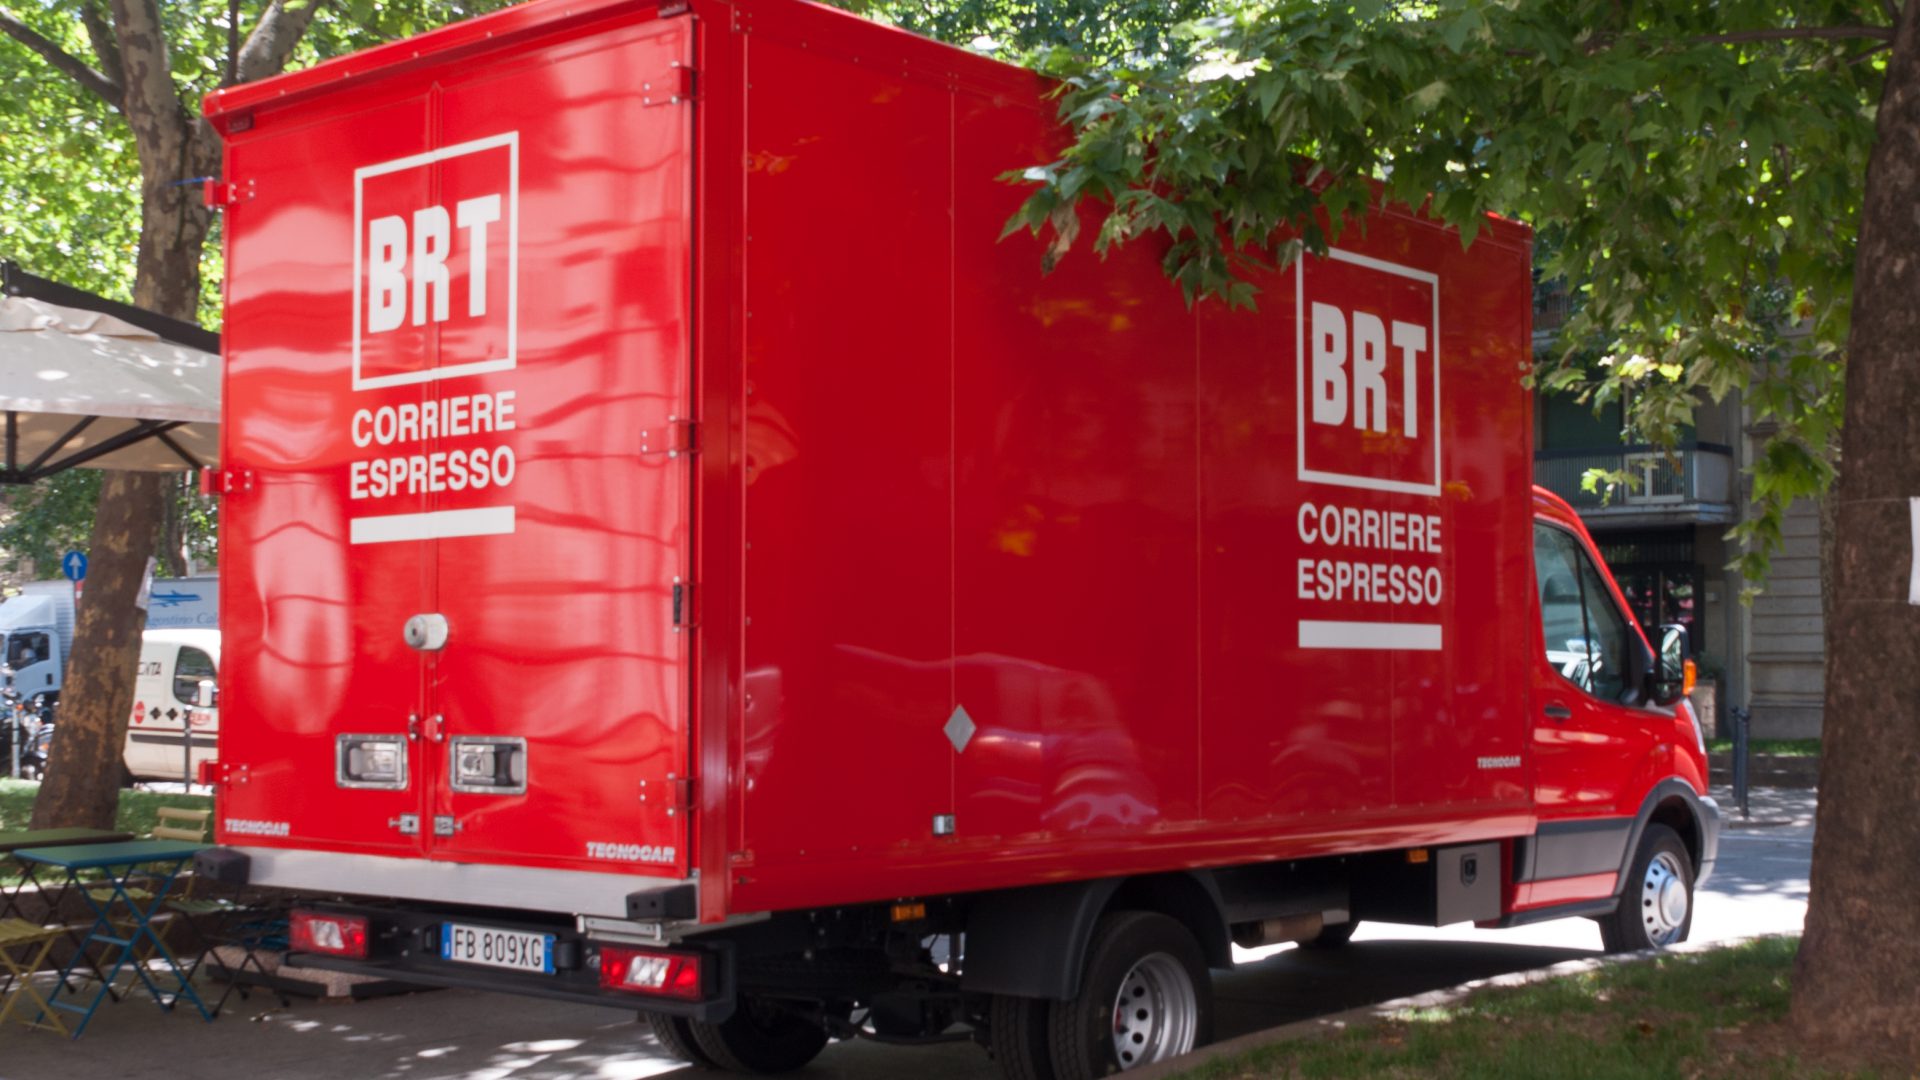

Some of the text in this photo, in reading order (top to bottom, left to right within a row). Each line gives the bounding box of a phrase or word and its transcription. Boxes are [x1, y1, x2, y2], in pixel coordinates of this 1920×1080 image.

[369, 193, 501, 333] BRT
[1311, 300, 1428, 439] BRT
[351, 390, 516, 447] CORRIERE
[350, 445, 516, 499] ESPRESSO
[1297, 502, 1442, 553] CORRIERE
[1297, 558, 1442, 606] ESPRESSO
[454, 928, 476, 959] FB
[483, 932, 542, 967] 809XG
